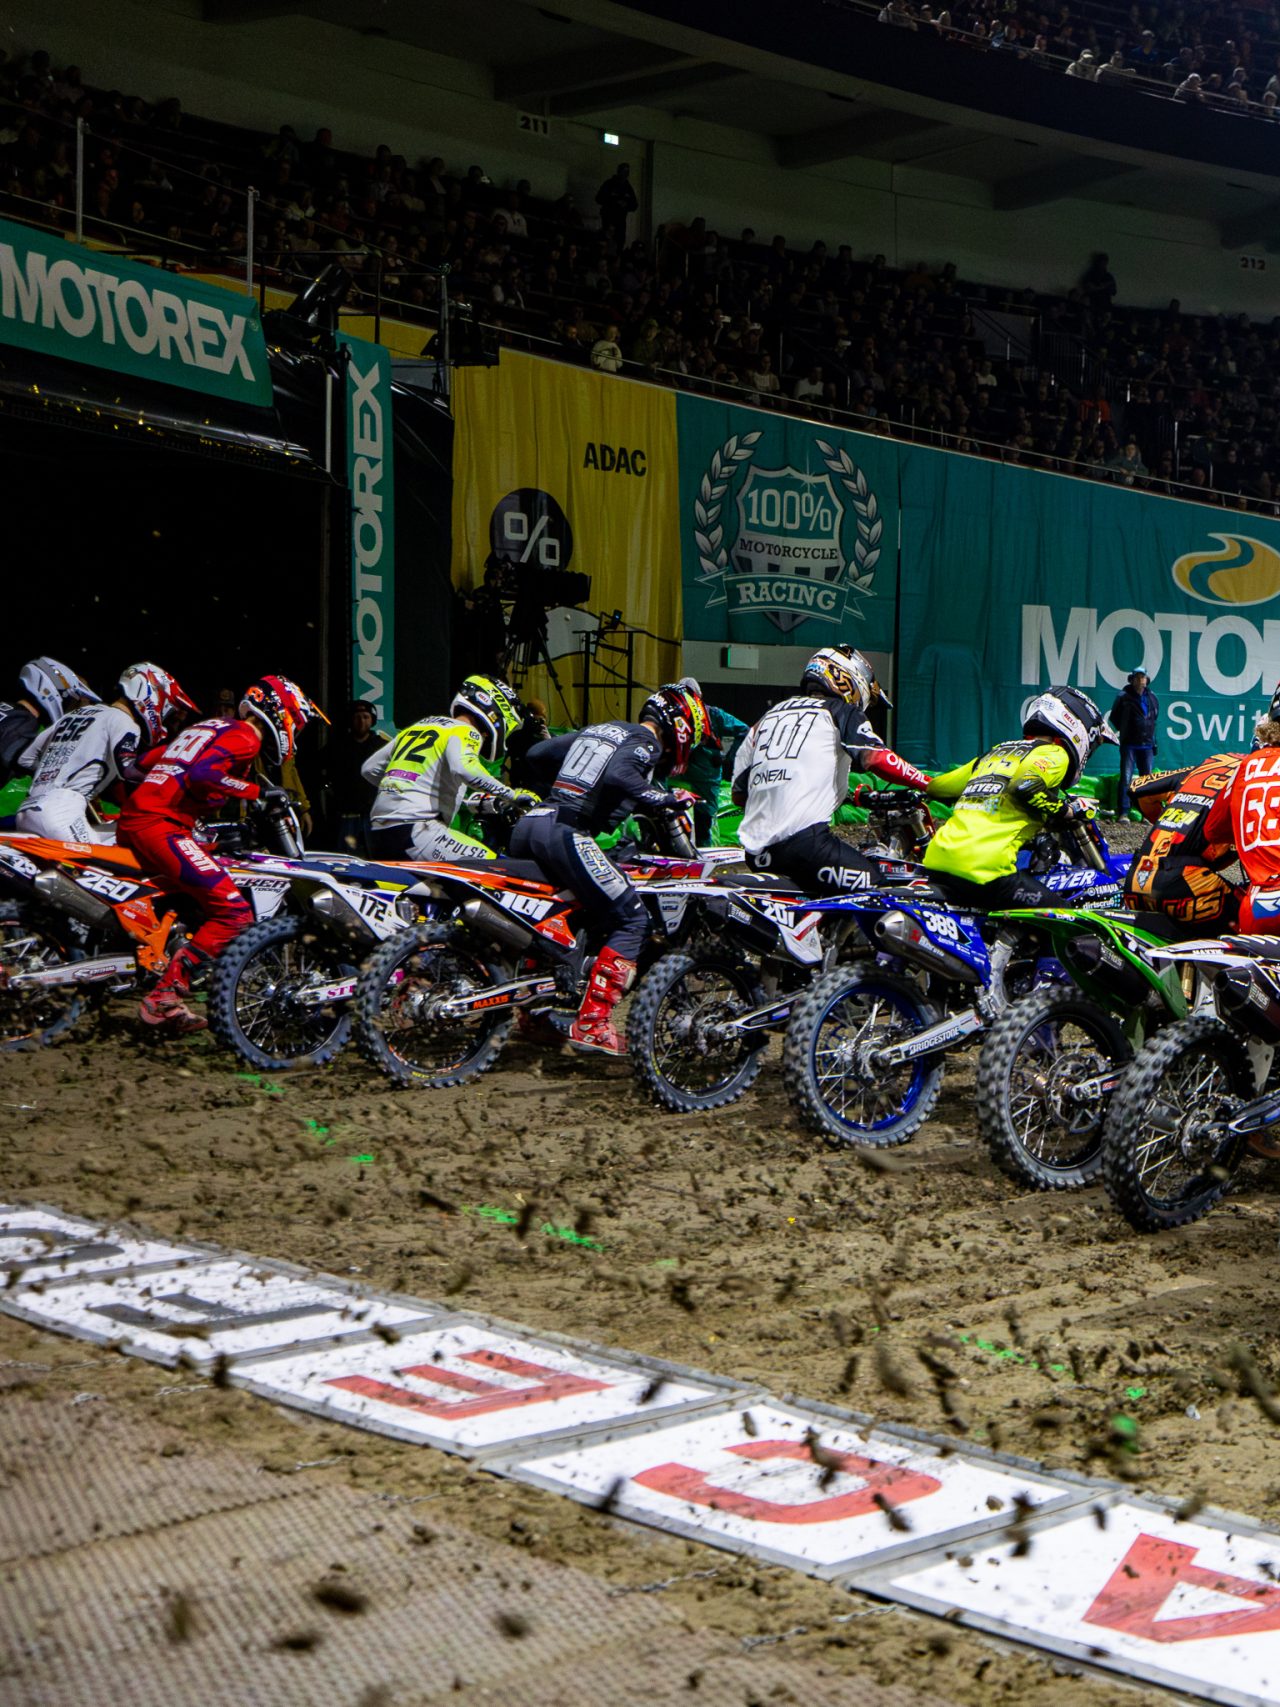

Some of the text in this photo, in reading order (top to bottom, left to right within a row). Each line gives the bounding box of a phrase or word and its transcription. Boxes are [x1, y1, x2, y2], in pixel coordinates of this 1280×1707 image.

[520, 115, 549, 135] 211
[0, 243, 256, 382] MOTOREX
[583, 442, 647, 477] ADAC
[748, 488, 833, 533] 100%
[347, 362, 385, 721] MOTOREX
[739, 538, 839, 560] MOTORCYCLE
[736, 581, 837, 611] RACING
[51, 716, 96, 742] 252
[752, 711, 819, 761] 201
[76, 869, 140, 902] 260
[1045, 869, 1098, 890] EYER
[358, 893, 389, 922] 172
[500, 889, 555, 922] 101
[922, 910, 959, 941] 389
